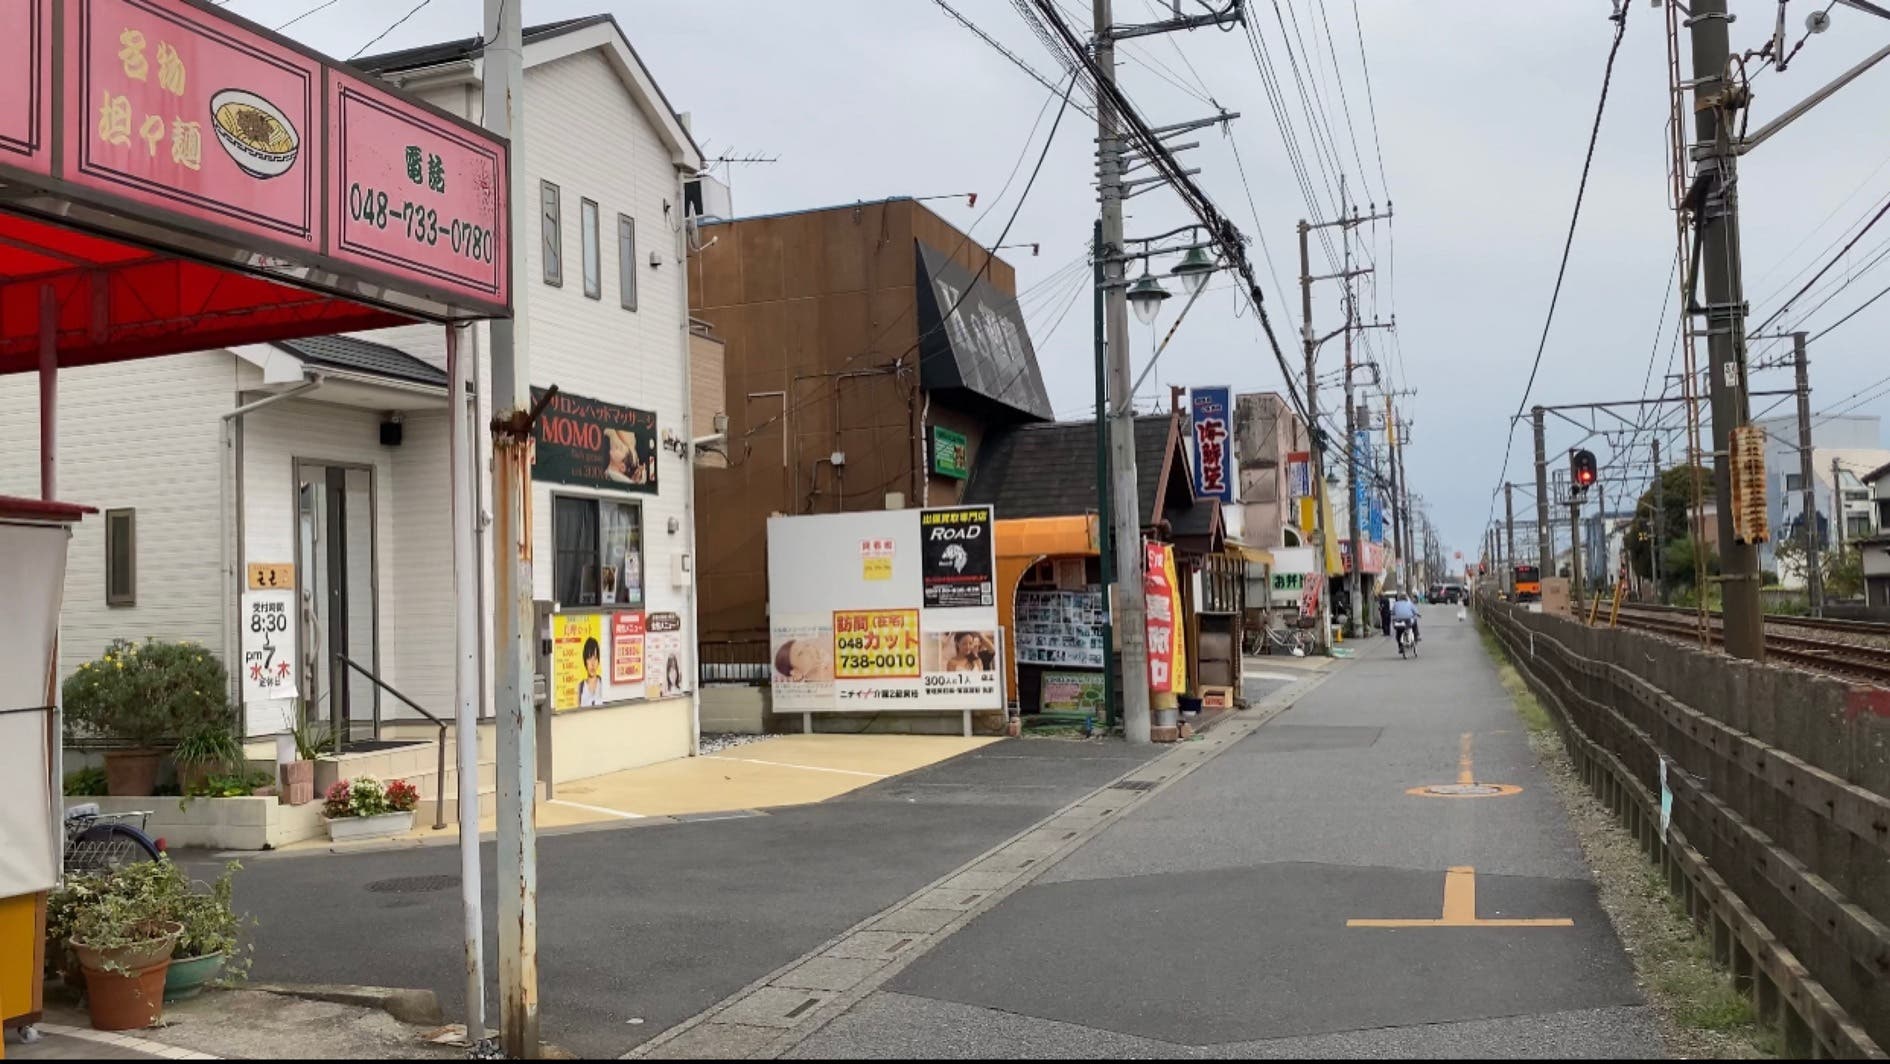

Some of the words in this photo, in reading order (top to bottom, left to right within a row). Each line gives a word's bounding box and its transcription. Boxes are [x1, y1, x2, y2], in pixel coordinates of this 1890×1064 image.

[118, 27, 186, 97] 名物
[406, 146, 445, 194] 電話
[350, 183, 492, 264] 048-733-0780
[541, 415, 602, 452] MOMO
[930, 525, 981, 541] ROAD
[252, 601, 285, 614] 受付時間
[250, 613, 287, 633] 8:30
[837, 615, 868, 633] 訪問
[838, 637, 864, 650] 048
[864, 630, 918, 650] カット
[245, 650, 263, 663] pm
[263, 645, 276, 669] 7
[840, 653, 916, 669] 738-0010
